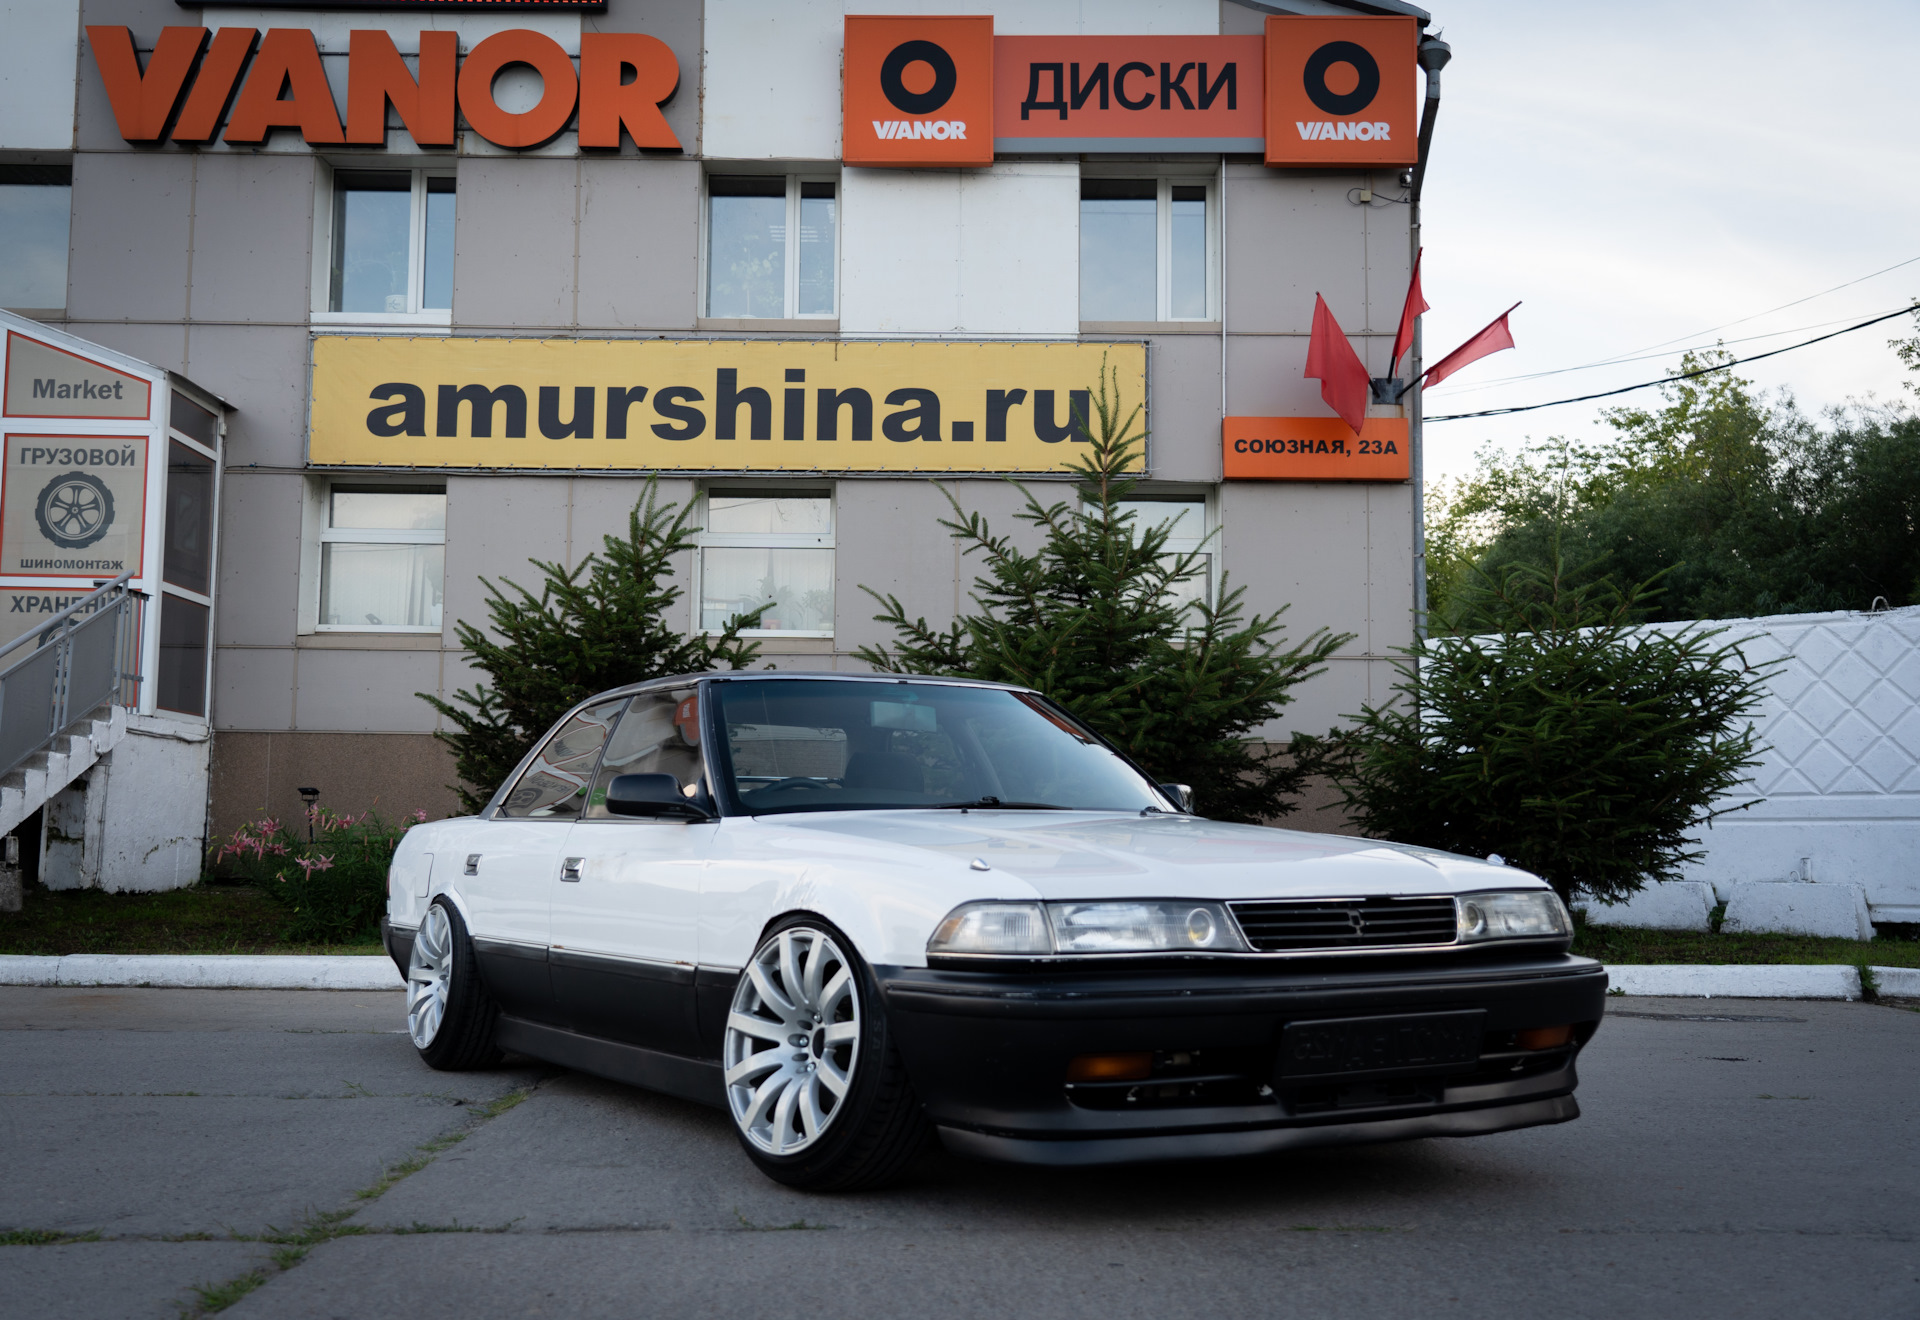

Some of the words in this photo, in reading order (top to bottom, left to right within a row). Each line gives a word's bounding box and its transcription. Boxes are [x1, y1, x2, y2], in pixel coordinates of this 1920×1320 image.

[85, 25, 684, 152] VIANOR
[1020, 61, 1238, 121] ДИСКИ
[872, 120, 967, 141] VIANOR
[1295, 121, 1391, 141] VIANOR
[32, 378, 123, 400] Market
[365, 368, 1091, 444] amurshina.ru
[20, 445, 136, 467] ГРУЗОВОЙ
[1234, 439, 1351, 457] СОЮЗНАЯ,
[1358, 440, 1398, 455] 23А
[20, 558, 124, 570] шиномонтаж
[10, 595, 129, 614] ХРАНЕН
